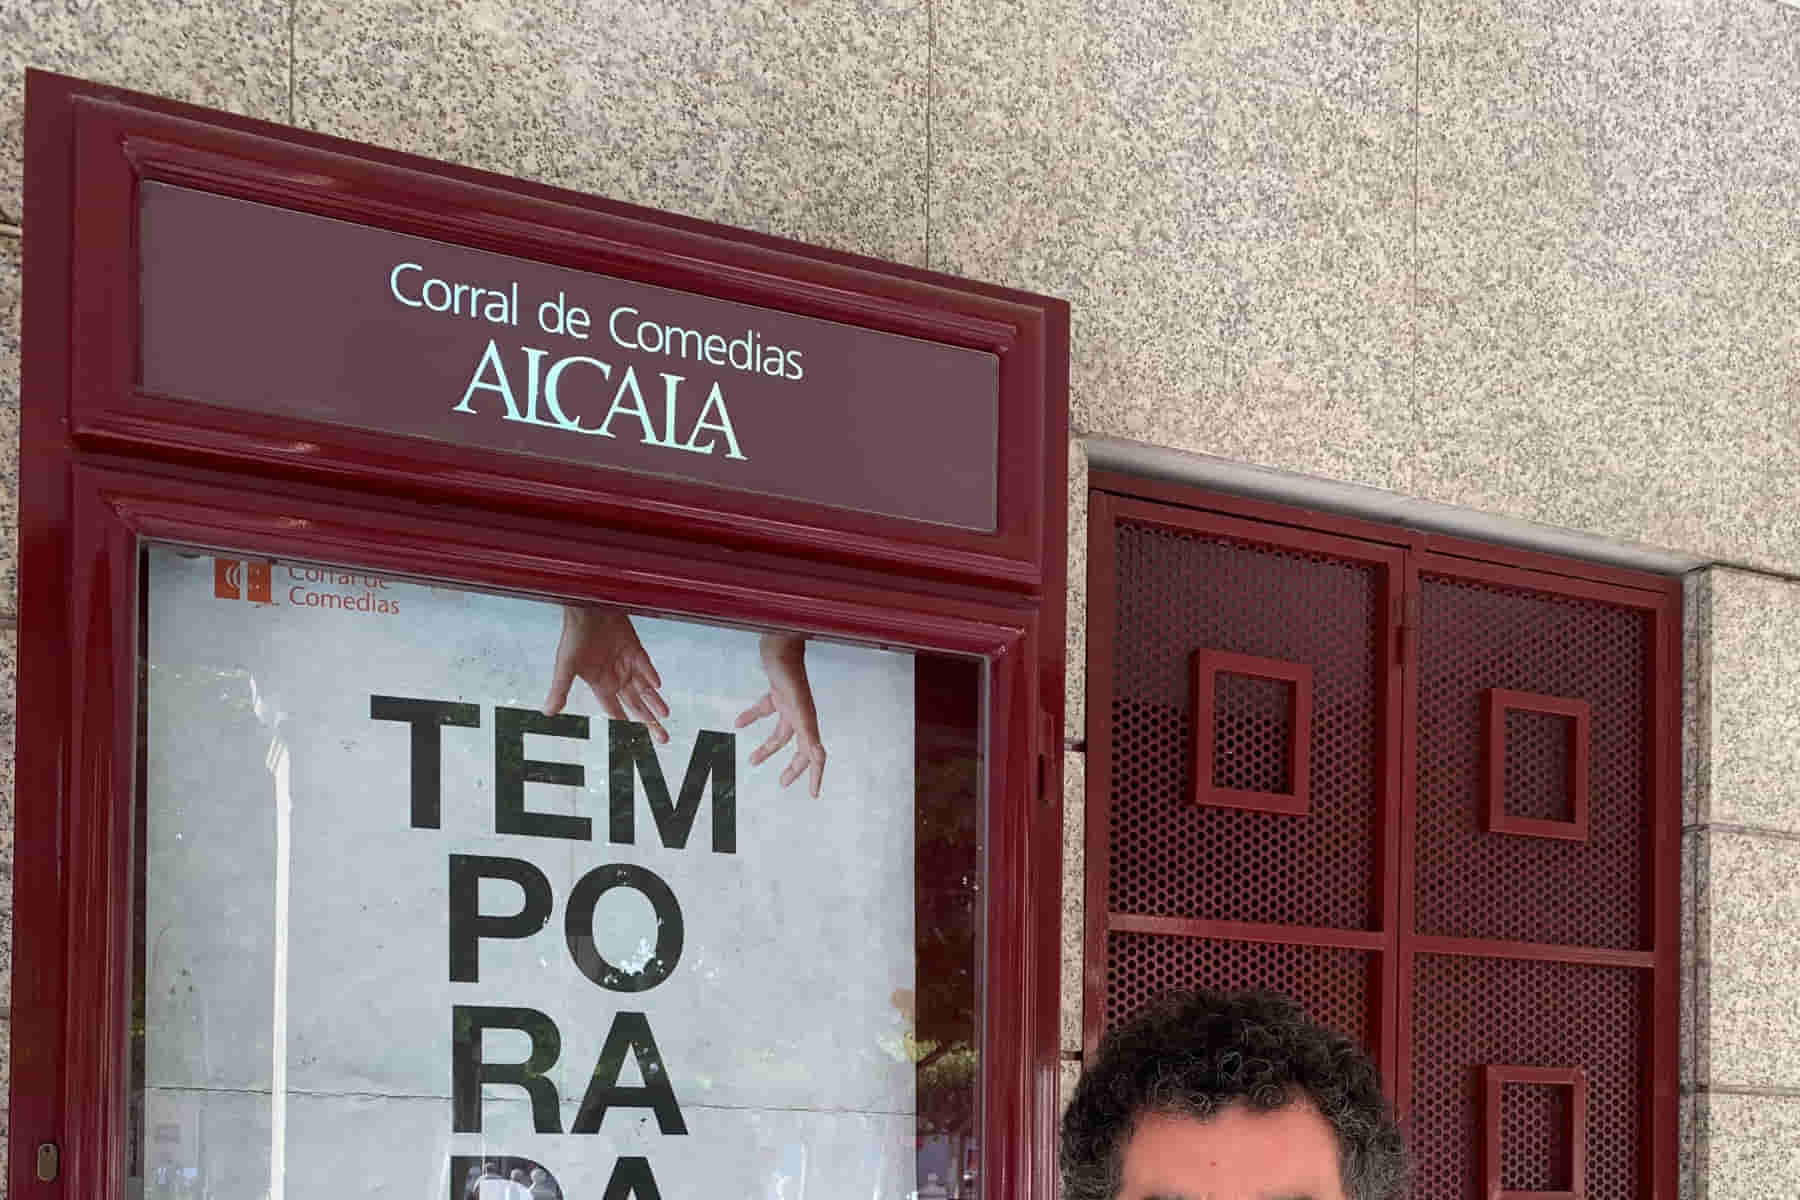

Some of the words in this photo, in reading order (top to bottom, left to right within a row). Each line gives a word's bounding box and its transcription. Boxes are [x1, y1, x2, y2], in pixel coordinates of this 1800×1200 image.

[390, 262, 519, 327] Corral
[537, 291, 592, 341] de
[608, 306, 805, 381] Comedias
[451, 338, 750, 461] ALCALA
[287, 585, 400, 615] Comedias
[370, 694, 737, 855] TEM
[448, 853, 685, 993] PO
[452, 1004, 689, 1136] RA
